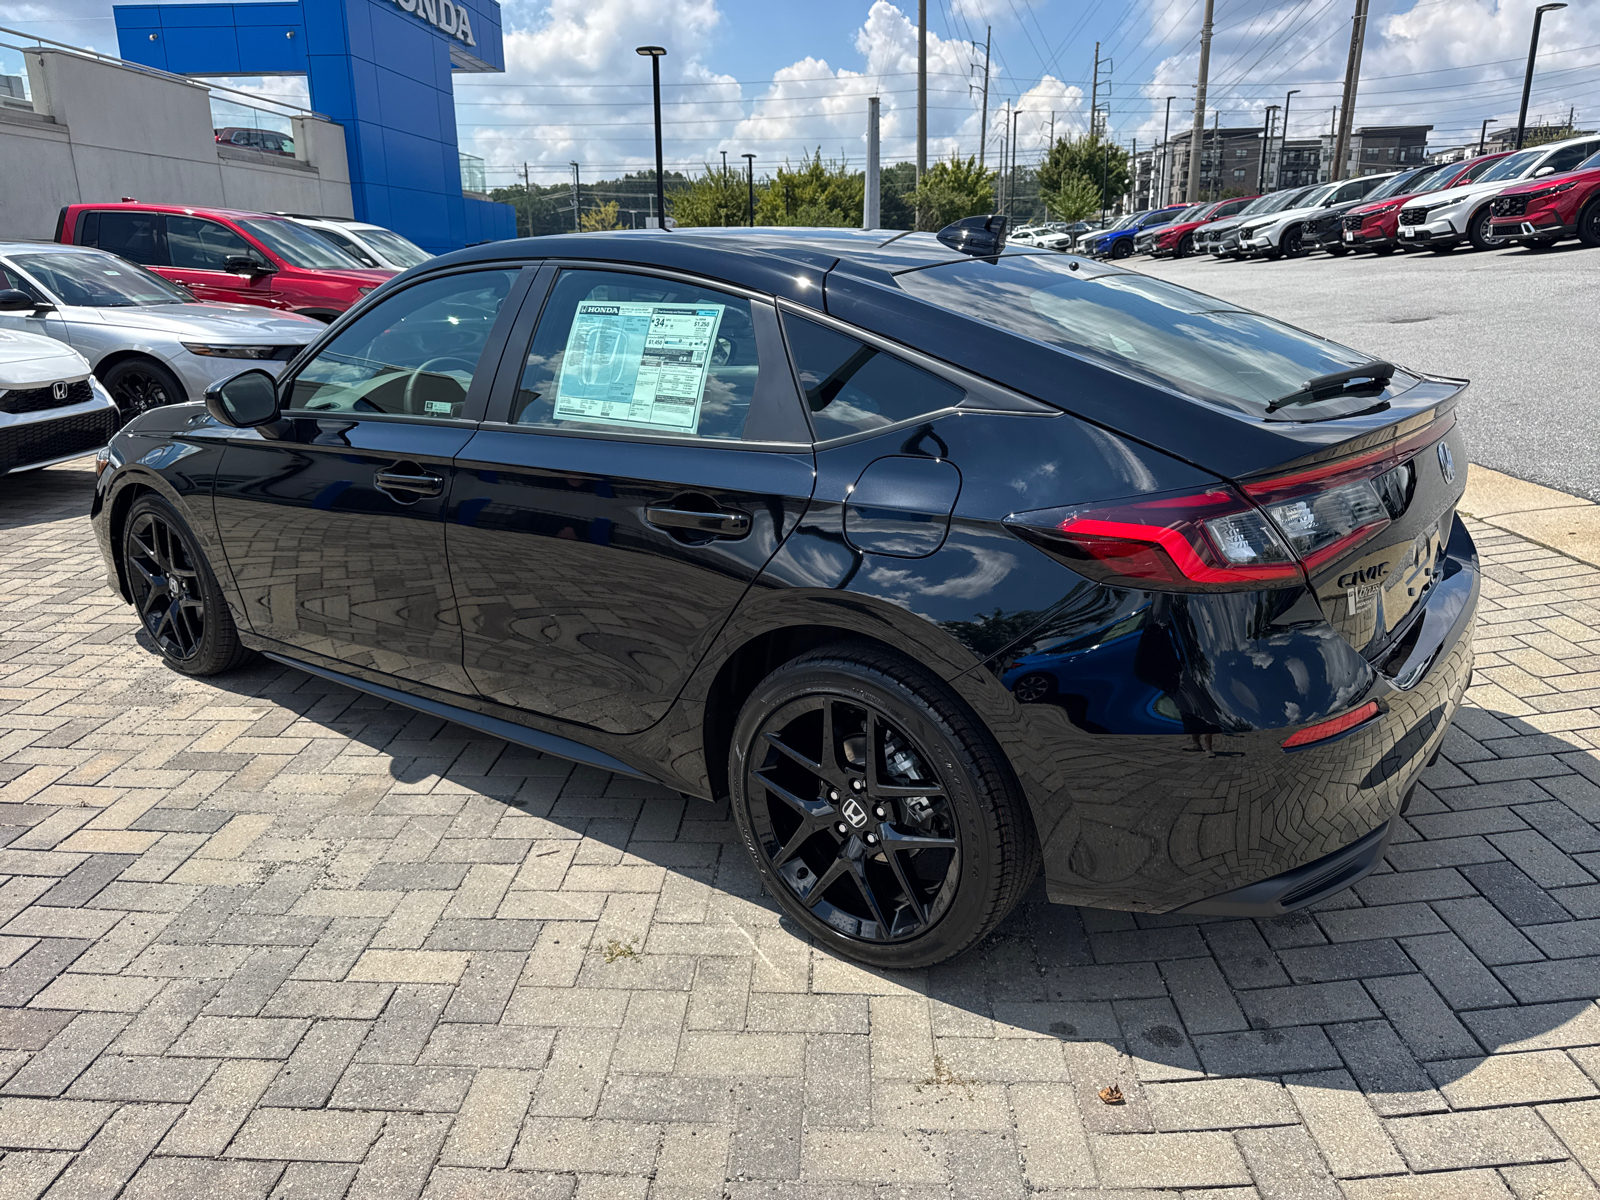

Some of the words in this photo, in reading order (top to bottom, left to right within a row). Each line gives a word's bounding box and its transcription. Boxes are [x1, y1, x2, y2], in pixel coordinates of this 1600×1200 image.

[388, 0, 476, 46] NDA
[587, 306, 618, 314] HONDA
[654, 318, 665, 327] 34
[1337, 561, 1390, 588] CIVIC
